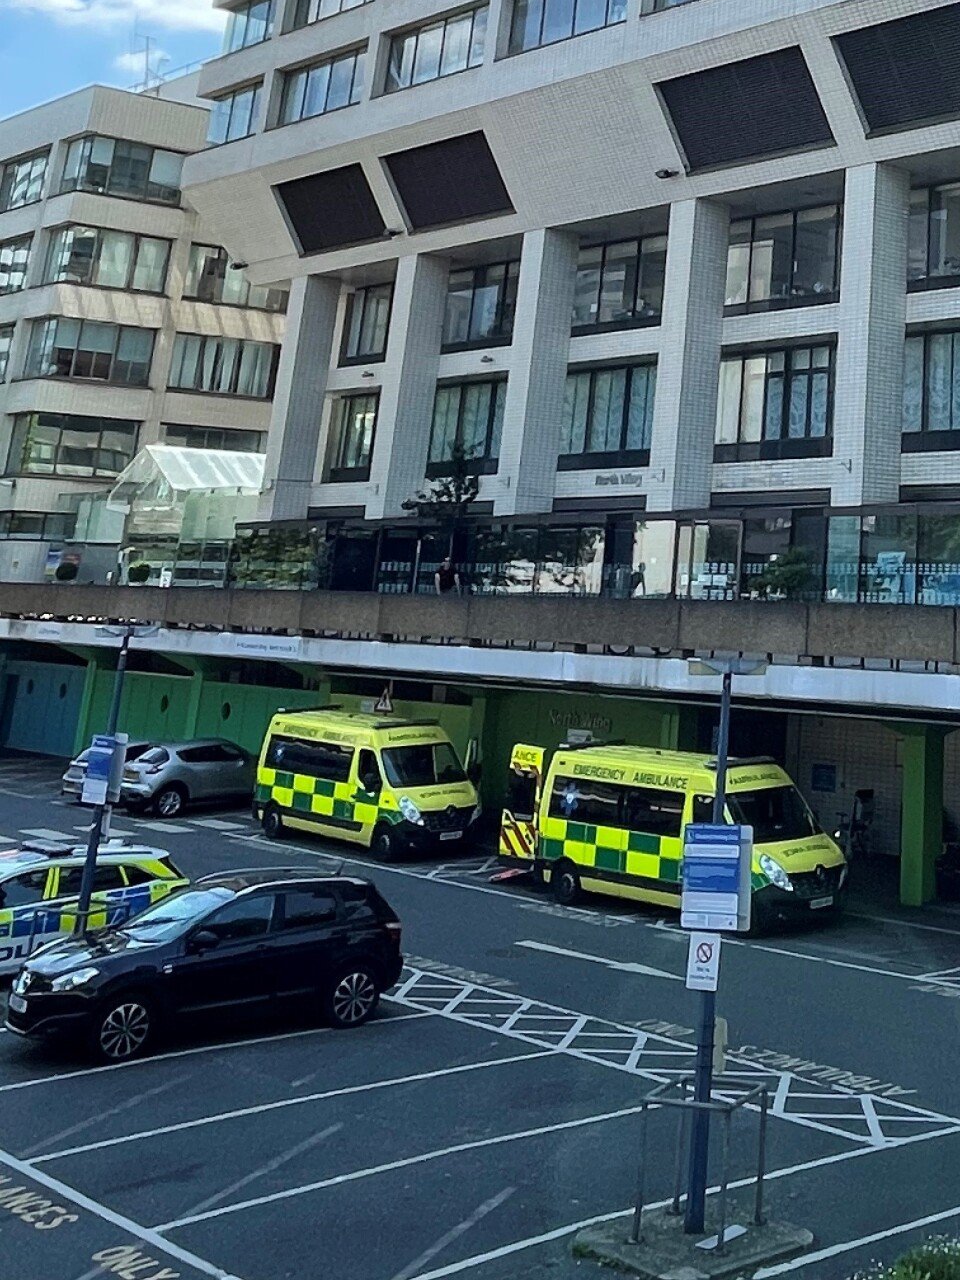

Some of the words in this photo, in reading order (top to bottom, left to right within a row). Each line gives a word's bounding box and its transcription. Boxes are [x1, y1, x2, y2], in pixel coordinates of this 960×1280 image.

[573, 764, 625, 782] EMERGENCY
[632, 772, 688, 790] AMBULANCE
[91, 1245, 182, 1280] ONLY
